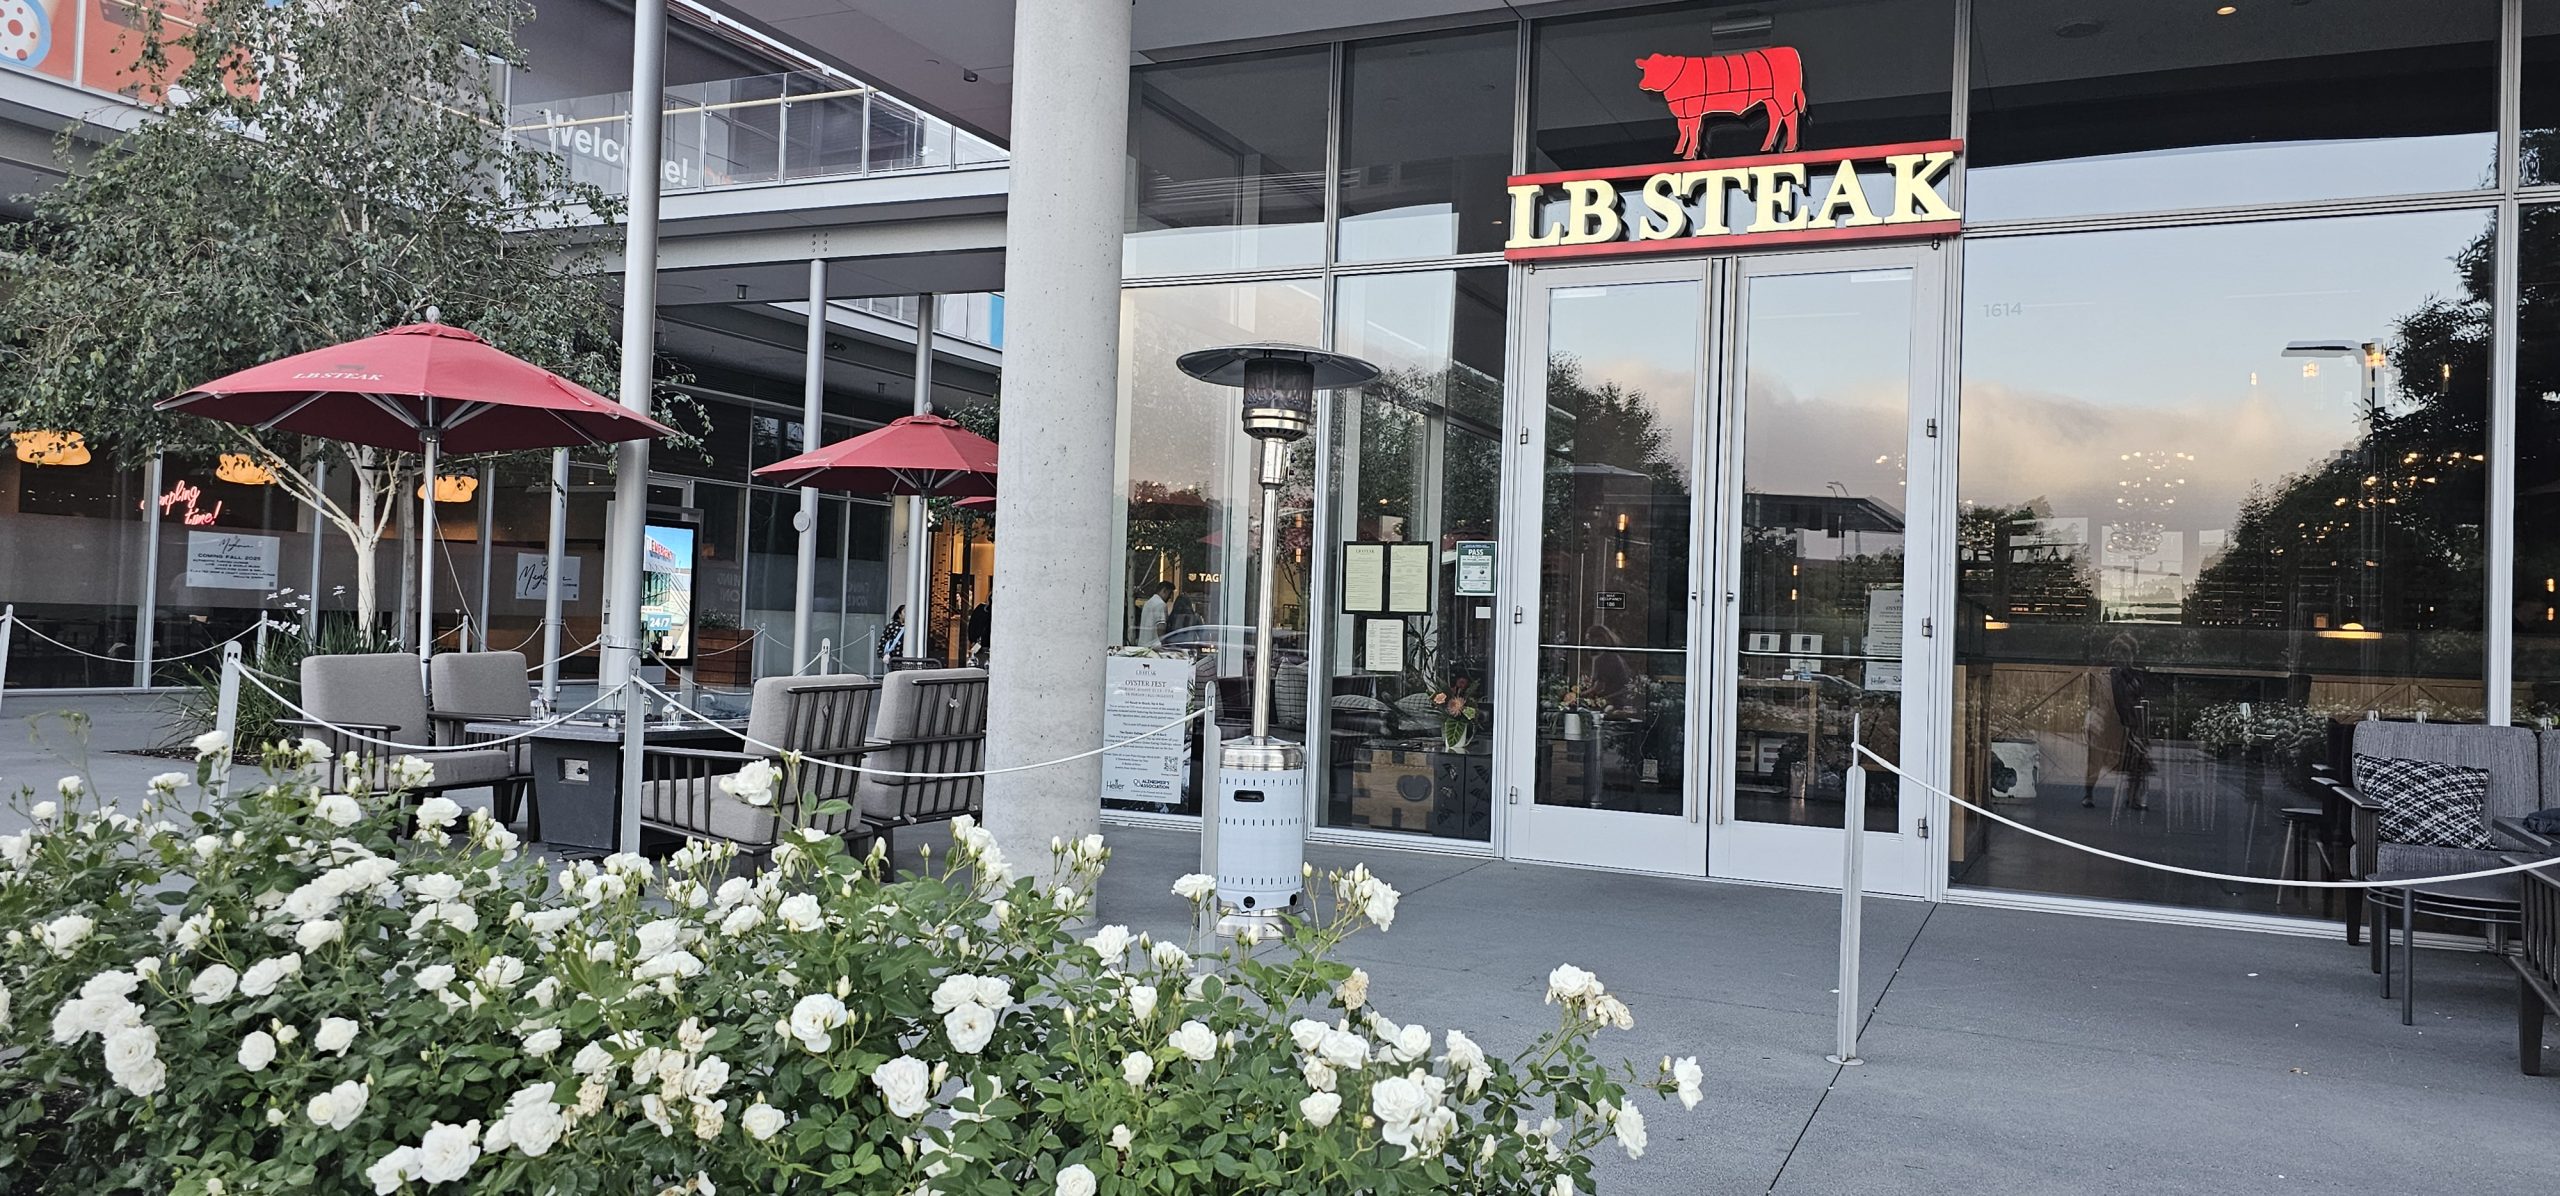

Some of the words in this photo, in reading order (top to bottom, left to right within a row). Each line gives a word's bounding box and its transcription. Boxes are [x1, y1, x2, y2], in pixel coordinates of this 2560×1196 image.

[545, 108, 688, 186] Welce!
[1505, 179, 1624, 249] LB
[1639, 151, 1961, 240] STEAK
[1983, 302, 2023, 318] 1614
[320, 372, 384, 380] STEAK
[184, 501, 223, 525] time!
[649, 617, 671, 628] 24/7
